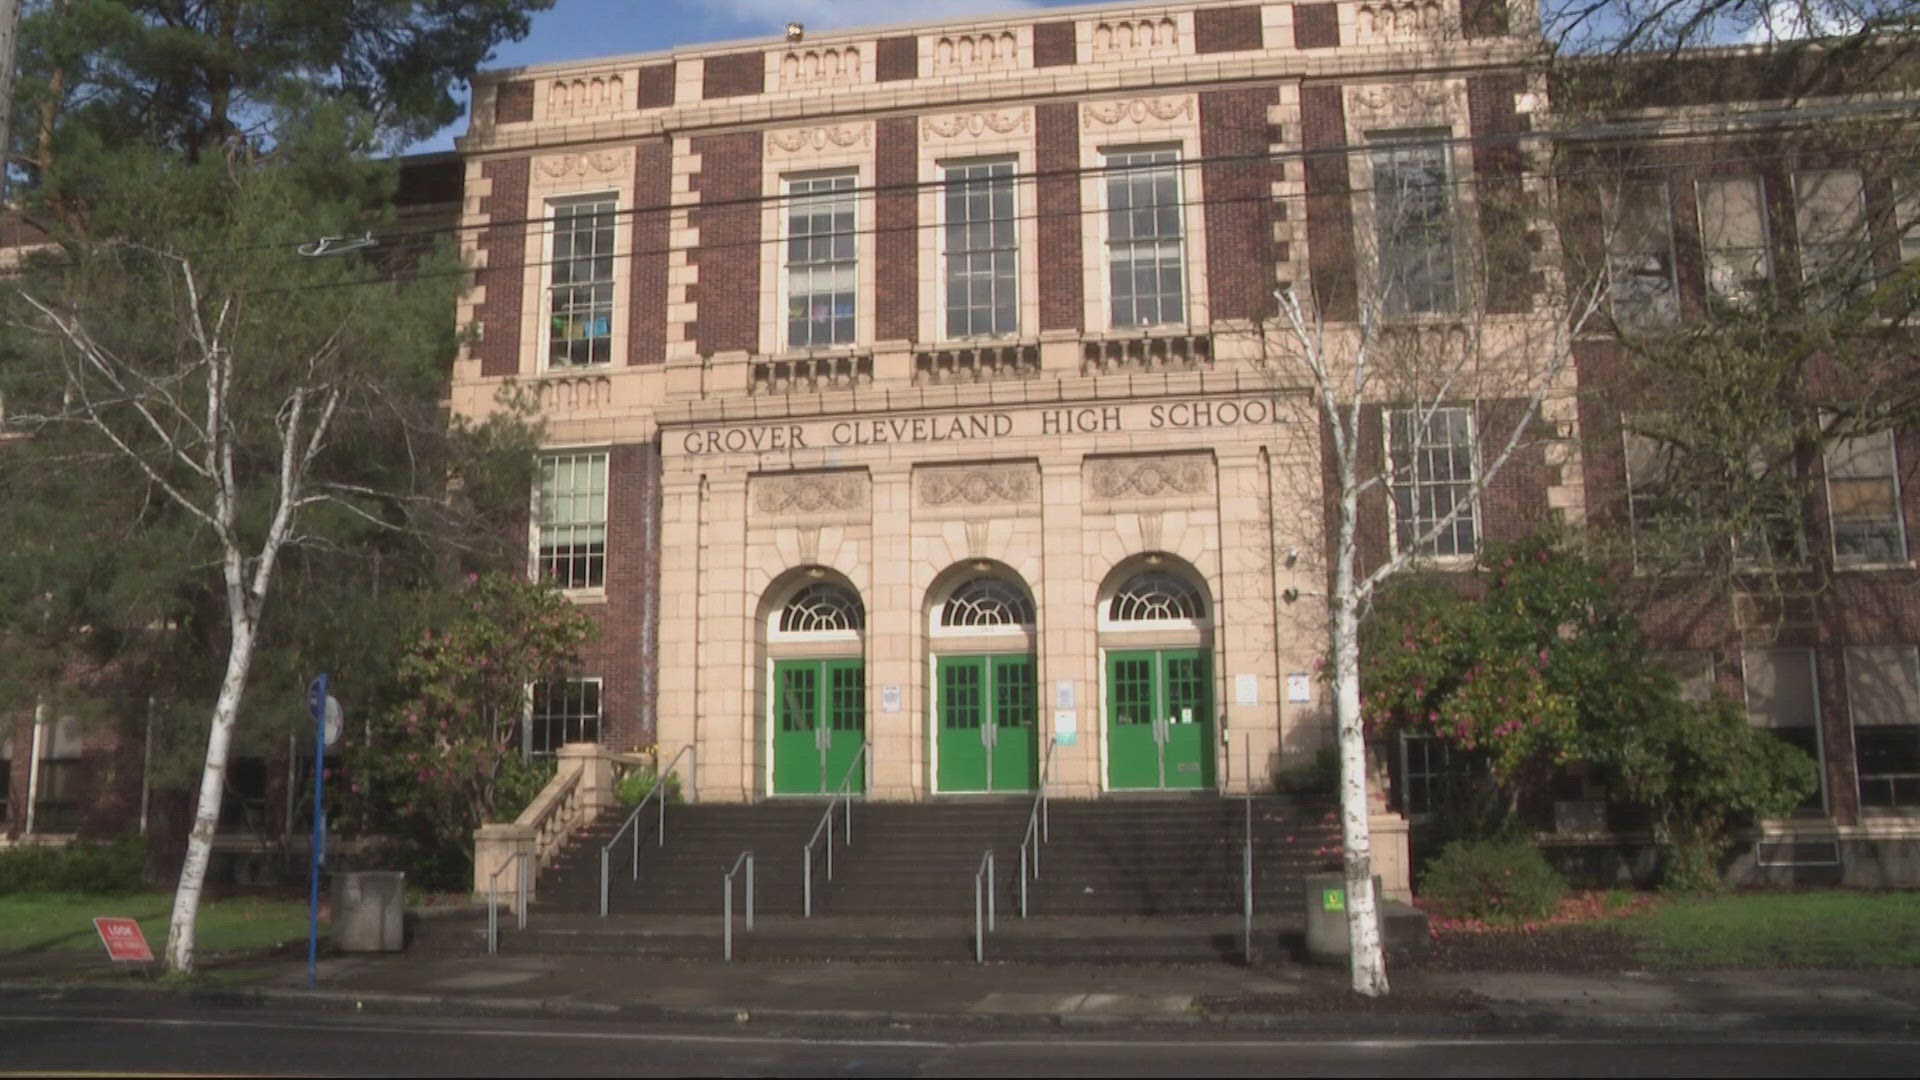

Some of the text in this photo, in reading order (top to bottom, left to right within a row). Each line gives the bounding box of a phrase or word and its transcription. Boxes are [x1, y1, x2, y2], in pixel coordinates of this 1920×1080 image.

[684, 399, 1287, 454] GROVER CLEVELAND HIGH SCHOOL
